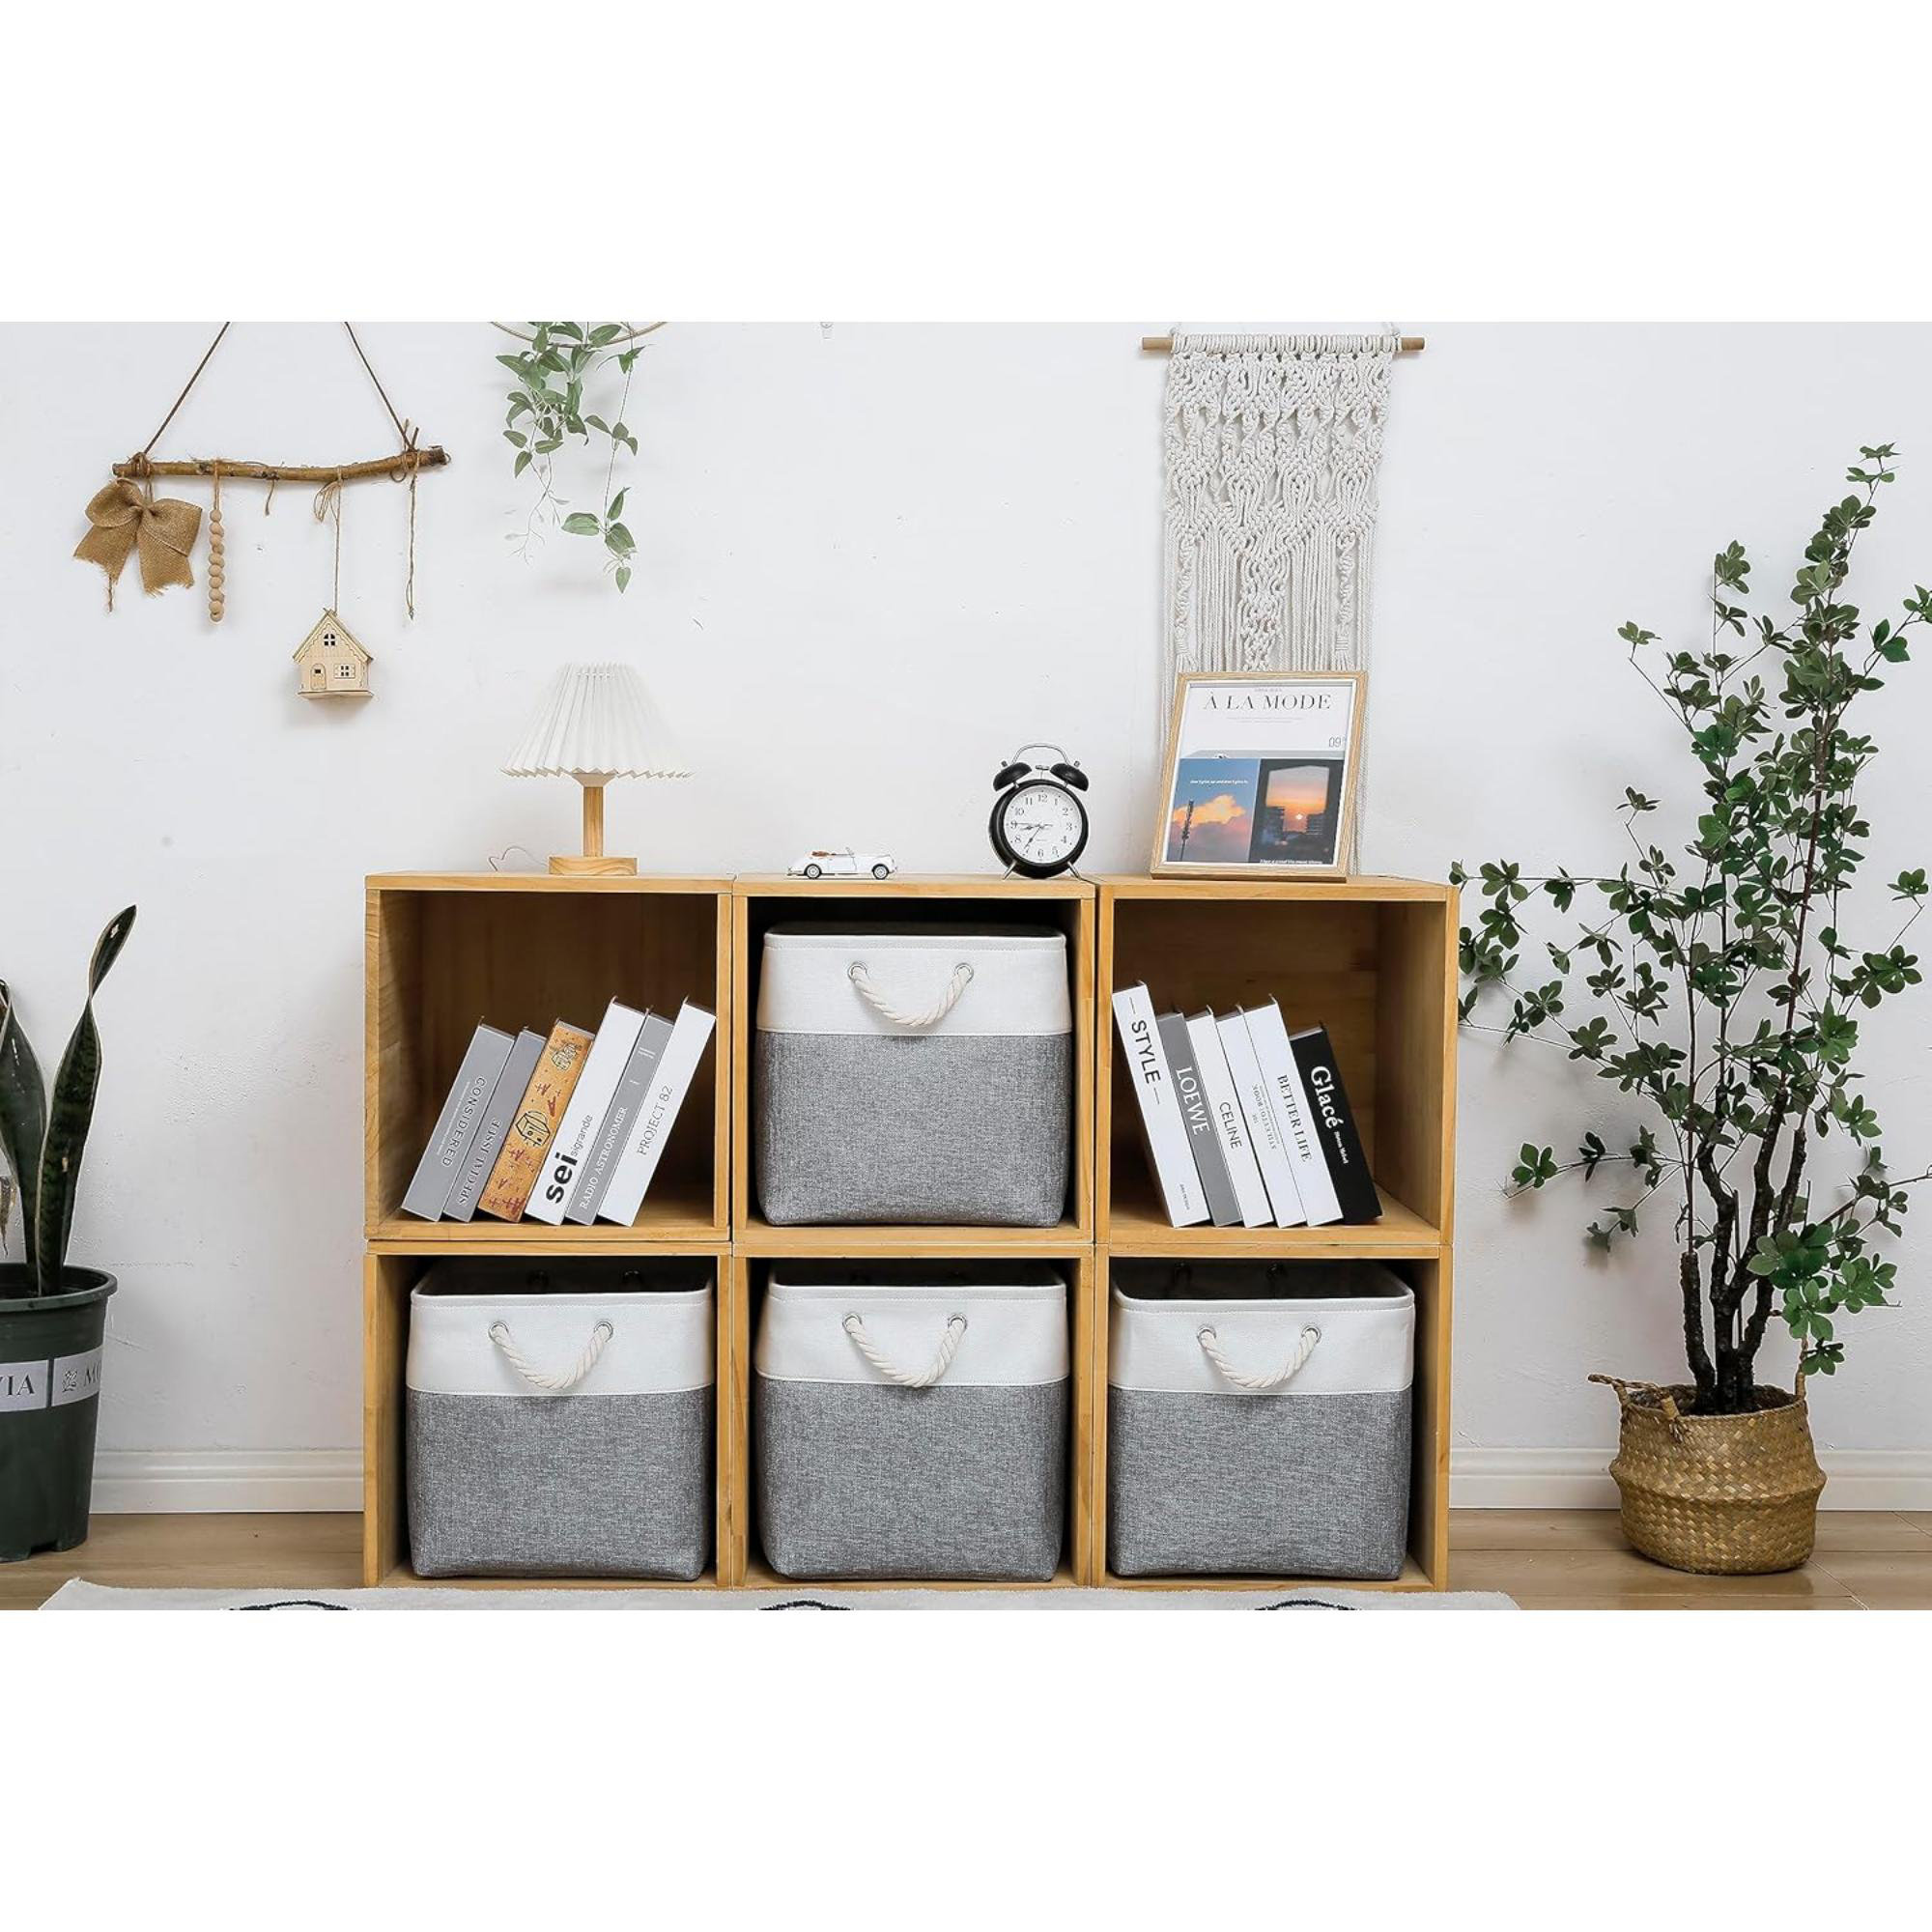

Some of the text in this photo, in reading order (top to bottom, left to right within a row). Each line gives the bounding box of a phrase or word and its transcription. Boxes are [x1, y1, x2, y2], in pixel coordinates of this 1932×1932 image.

[1226, 694, 1254, 710] LA
[1263, 694, 1332, 710] MODE
[1037, 793, 1048, 804] 12
[1131, 1020, 1161, 1085] STYLE
[441, 1076, 487, 1167] CONSIDERED
[637, 1085, 673, 1156] PROJECT 82
[1175, 1065, 1210, 1136] LOEWE
[1219, 1101, 1242, 1151] CELINE
[1277, 1074, 1313, 1163] BETTER LIFE
[1311, 1065, 1345, 1129] Glacé
[458, 1118, 501, 1206] SPECIAL ISSUE
[545, 1151, 578, 1204] sei
[580, 1106, 629, 1209] RADIO ASTRONOMER
[0, 1374, 35, 1397] IA
